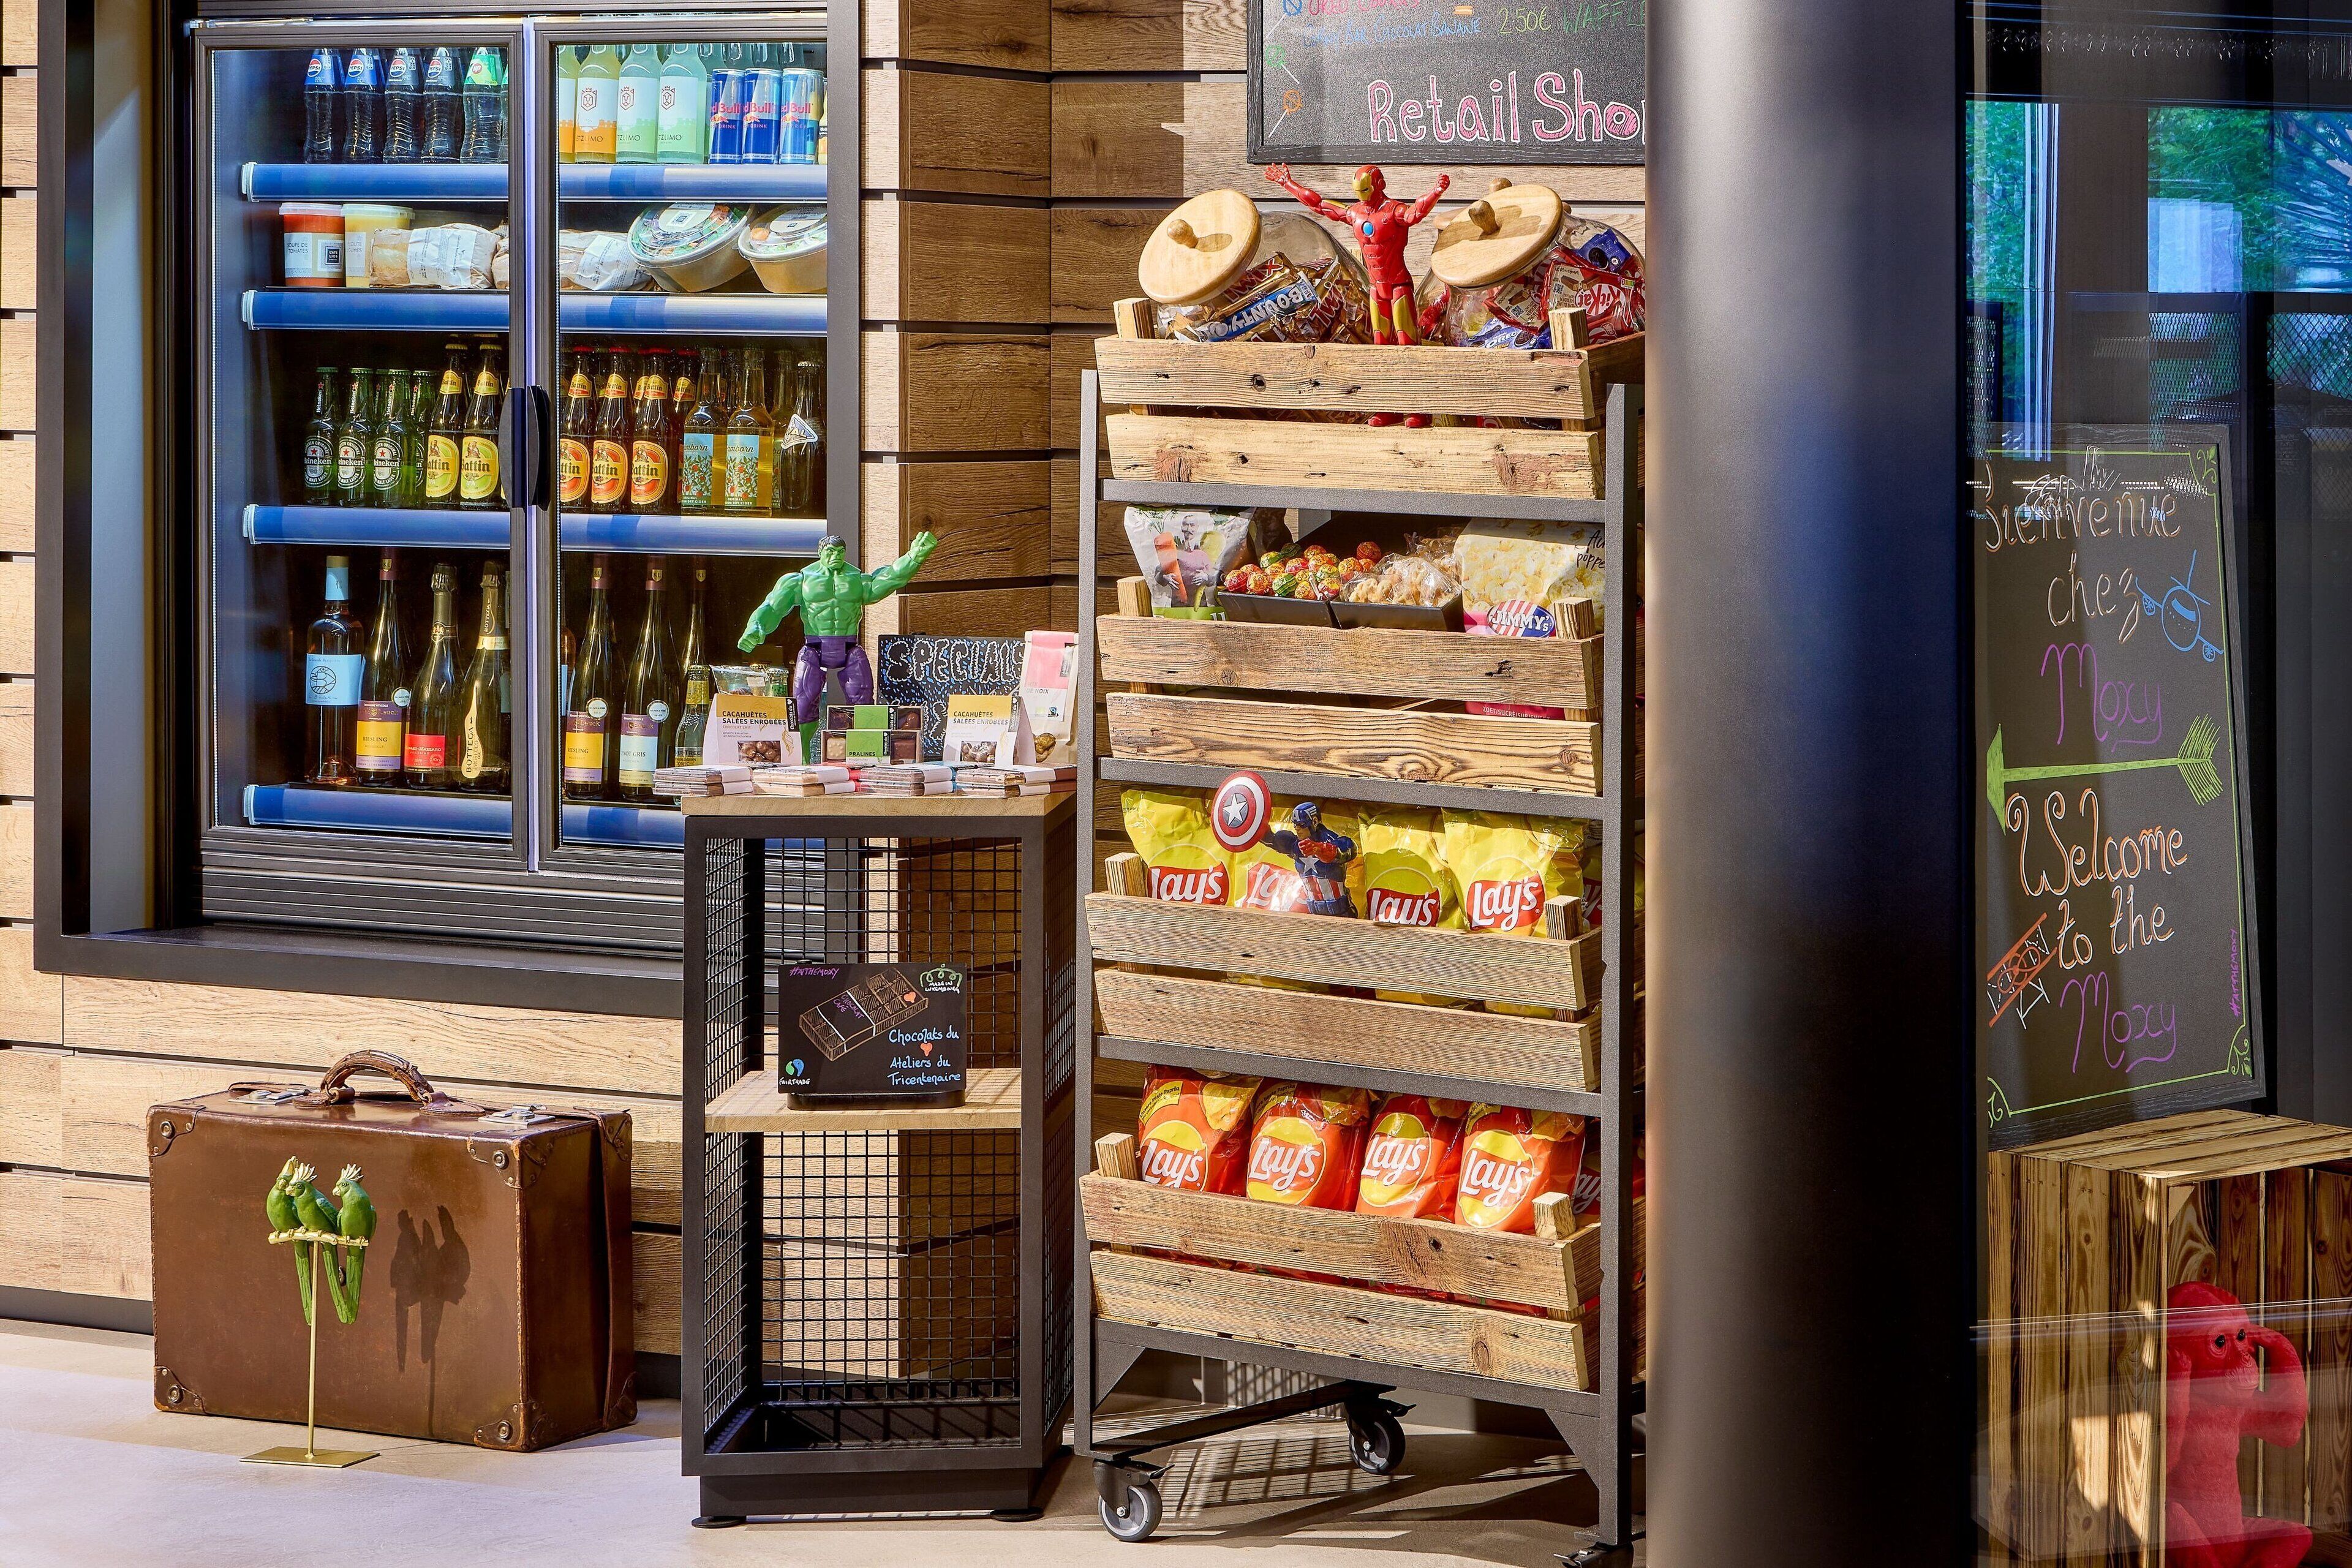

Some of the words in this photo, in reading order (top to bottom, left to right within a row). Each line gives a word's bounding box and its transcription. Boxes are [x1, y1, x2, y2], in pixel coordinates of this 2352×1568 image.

[791, 102, 811, 114] Bull
[1367, 70, 1521, 143] Retail
[1531, 68, 1645, 143] Sho
[1231, 285, 1304, 333] BOUNTY
[1576, 284, 1622, 316] KitKat
[428, 459, 450, 471] attin
[560, 462, 581, 474] ttin
[594, 462, 619, 476] attin
[684, 443, 709, 452] amborn
[2047, 549, 2140, 644] chez
[2040, 642, 2164, 753] Moxy
[466, 726, 474, 773] BOTTEGA
[2006, 787, 2188, 897] Welcome
[1150, 865, 1224, 904] Lay's
[1471, 876, 1539, 932] Lay's
[2056, 898, 2094, 970] to
[2109, 883, 2174, 955] the
[841, 993, 864, 1019] CHOCOLAT
[2059, 971, 2178, 1074] Moxy
[888, 1028, 943, 1046] Chocolats
[946, 1025, 960, 1040] du
[887, 1071, 961, 1086] Tricentenaire
[889, 1055, 931, 1069] Ateliers
[937, 1054, 951, 1068] du
[1164, 1086, 1180, 1095] Paprika
[1141, 1139, 1204, 1188] Lay's
[1248, 1136, 1321, 1191] Lay's
[1360, 1134, 1428, 1186] Lay's
[1460, 1149, 1530, 1207] Lay's
